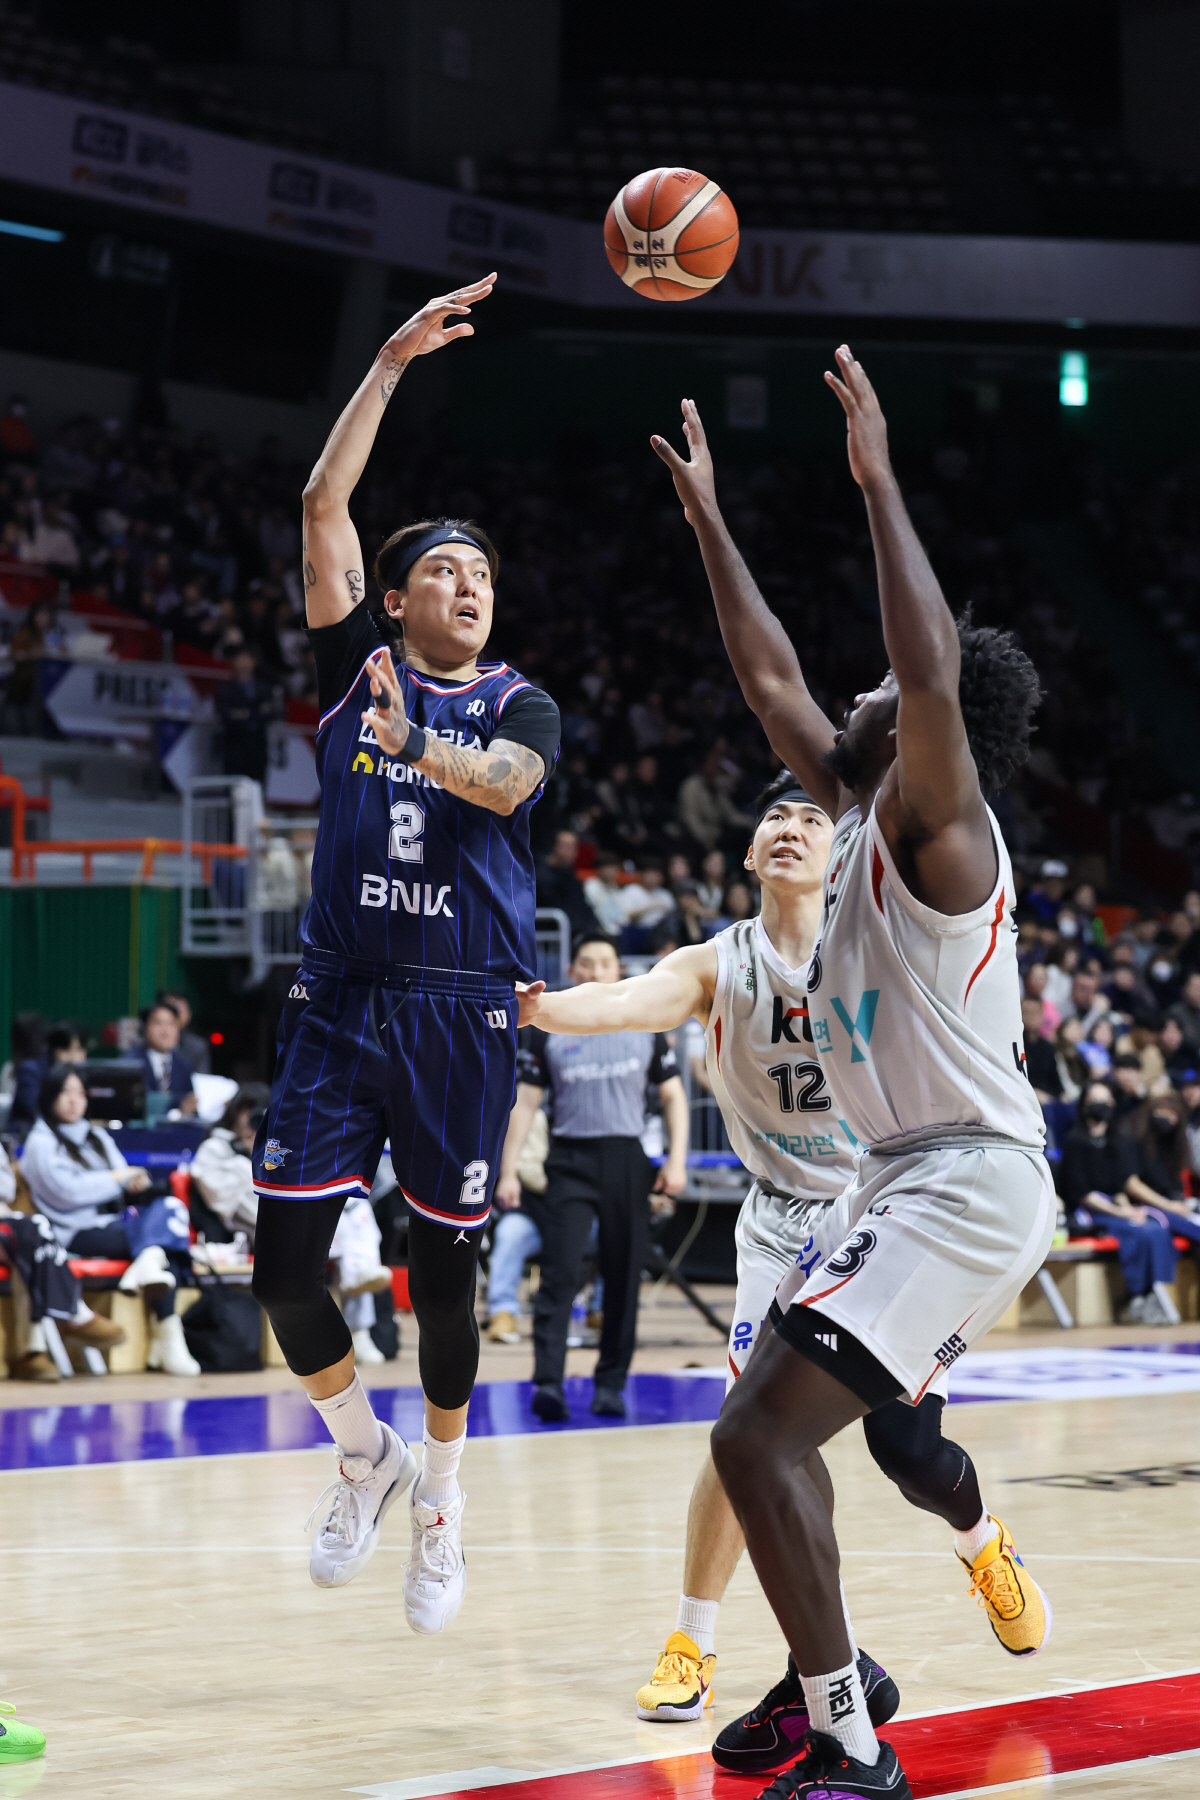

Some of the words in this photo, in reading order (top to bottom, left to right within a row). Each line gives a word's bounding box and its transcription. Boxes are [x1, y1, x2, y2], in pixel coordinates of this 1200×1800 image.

[388, 800, 426, 864] 2
[360, 874, 455, 918] BNK
[768, 1061, 832, 1113] 12
[458, 1159, 490, 1205] 2
[824, 1229, 877, 1277] 3
